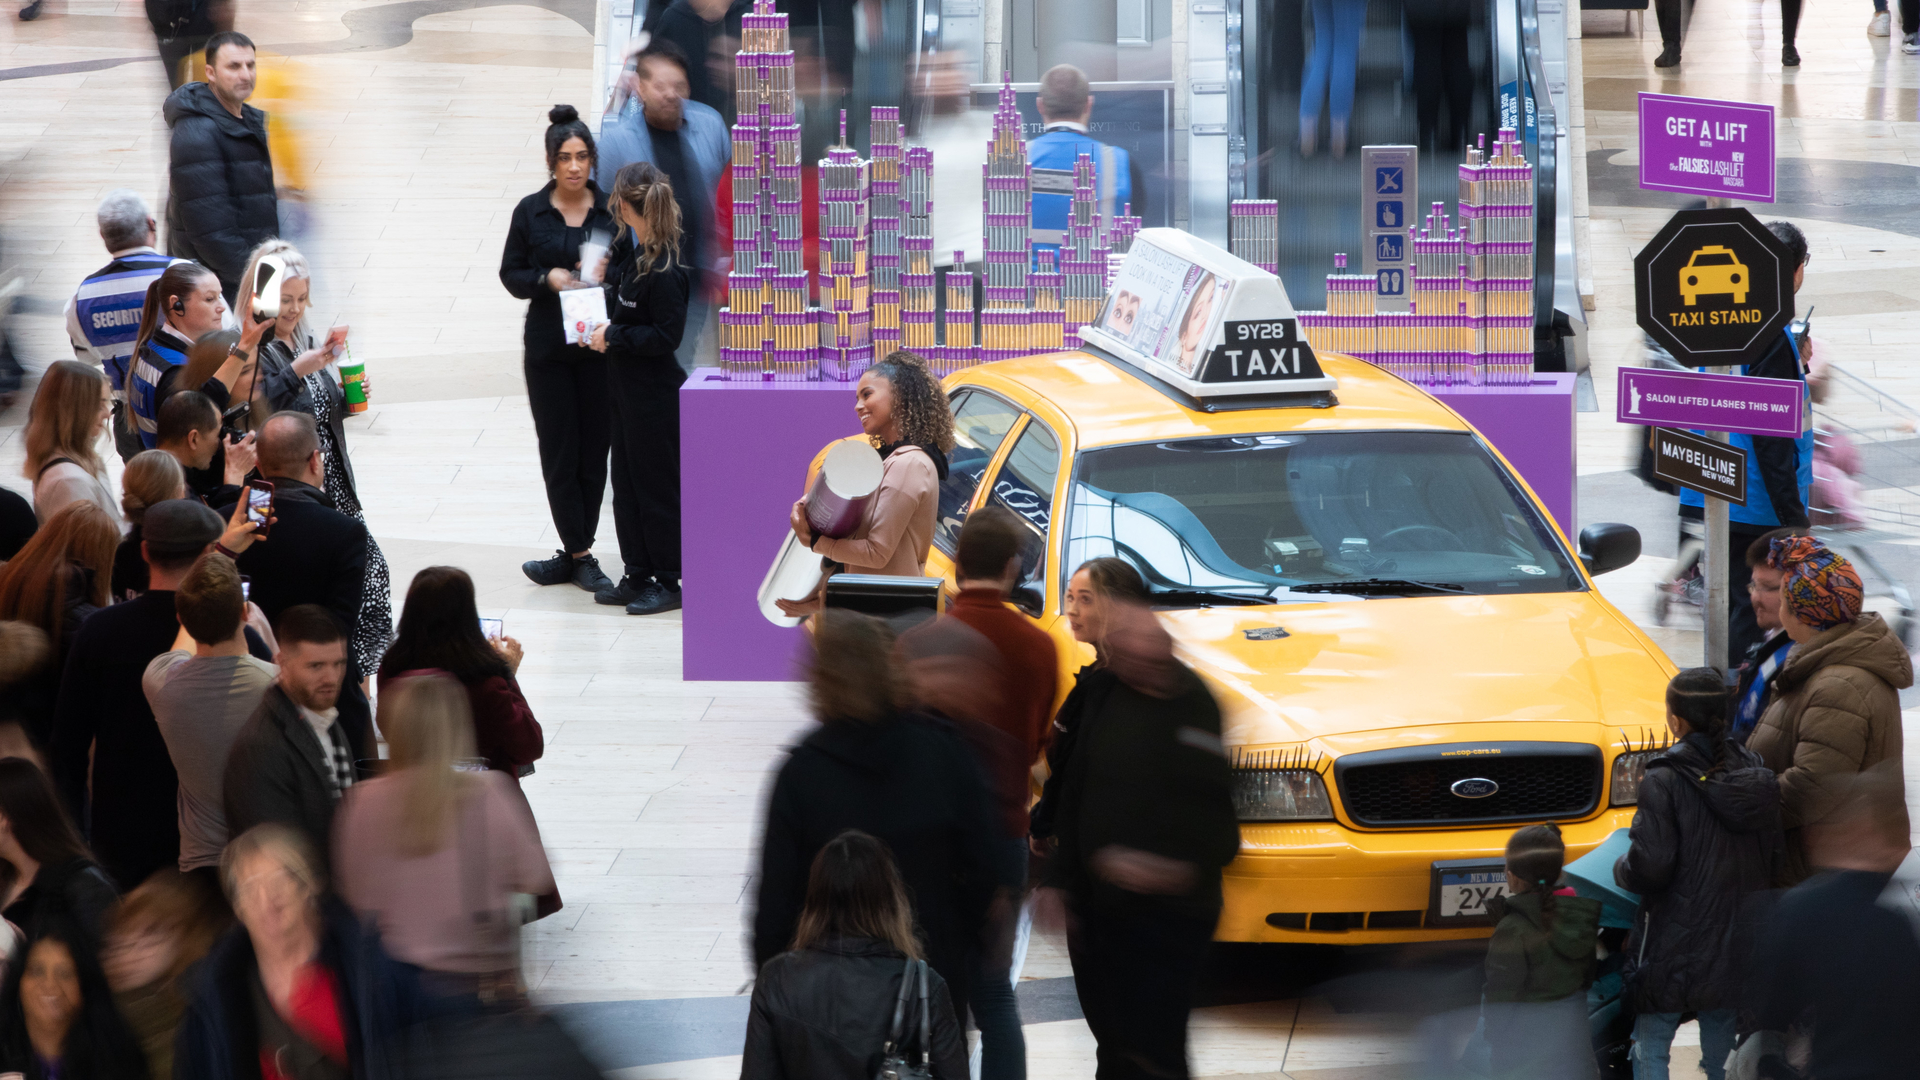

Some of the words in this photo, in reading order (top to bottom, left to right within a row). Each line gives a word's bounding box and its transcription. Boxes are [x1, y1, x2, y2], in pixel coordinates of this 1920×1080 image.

[1501, 108, 1510, 128] BRUS
[1666, 116, 1696, 137] GET
[1700, 120, 1711, 139] A
[1715, 121, 1748, 143] LIFT
[1732, 151, 1745, 162] NEW
[1669, 162, 1679, 171] the
[1678, 157, 1709, 174] FALSIES
[1710, 160, 1729, 176] LASH
[1729, 162, 1745, 178] LIFT
[1723, 176, 1745, 187] MASCARA
[1138, 244, 1159, 265] SALON
[1669, 311, 1704, 327] TAXI
[1709, 309, 1762, 325] STAND
[1237, 323, 1284, 340] 9Y28
[1224, 347, 1301, 376] TAXI
[1646, 393, 1676, 404] SALON
[1678, 396, 1709, 406] LIFTED
[1711, 398, 1746, 410] LASHES
[1748, 402, 1768, 412] THIS
[1771, 404, 1790, 413] WAY
[1662, 440, 1737, 478] MAYBELLINE
[1701, 469, 1717, 480] NEW
[1717, 472, 1736, 487] YORK
[1441, 748, 1501, 757] www.cop-cars.eu
[1462, 782, 1488, 794] Ford
[1470, 873, 1489, 883] NEW
